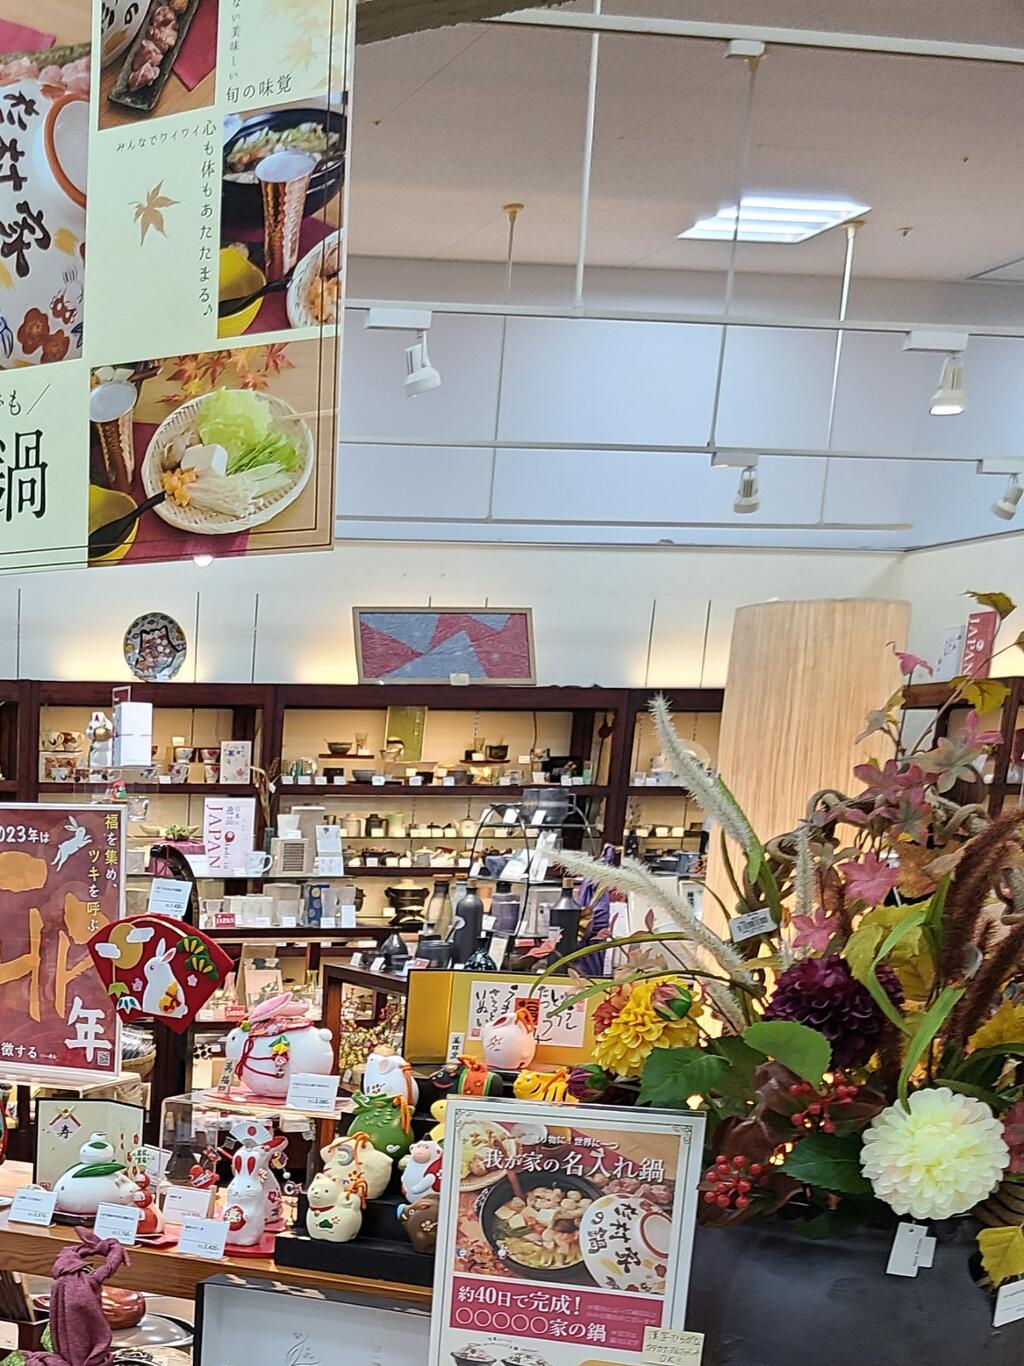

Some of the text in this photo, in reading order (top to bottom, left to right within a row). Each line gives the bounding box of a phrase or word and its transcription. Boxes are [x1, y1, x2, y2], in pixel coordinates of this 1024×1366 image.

[226, 74, 292, 103] 旬の味覚
[116, 125, 201, 152] みんなでワイワイ
[104, 814, 119, 888] 福を集め、
[206, 804, 223, 869] JAPAN
[86, 849, 101, 932] ツキを呼ぶ
[64, 996, 112, 1062] 年
[483, 1148, 665, 1183] 我が家の名入れ鍋
